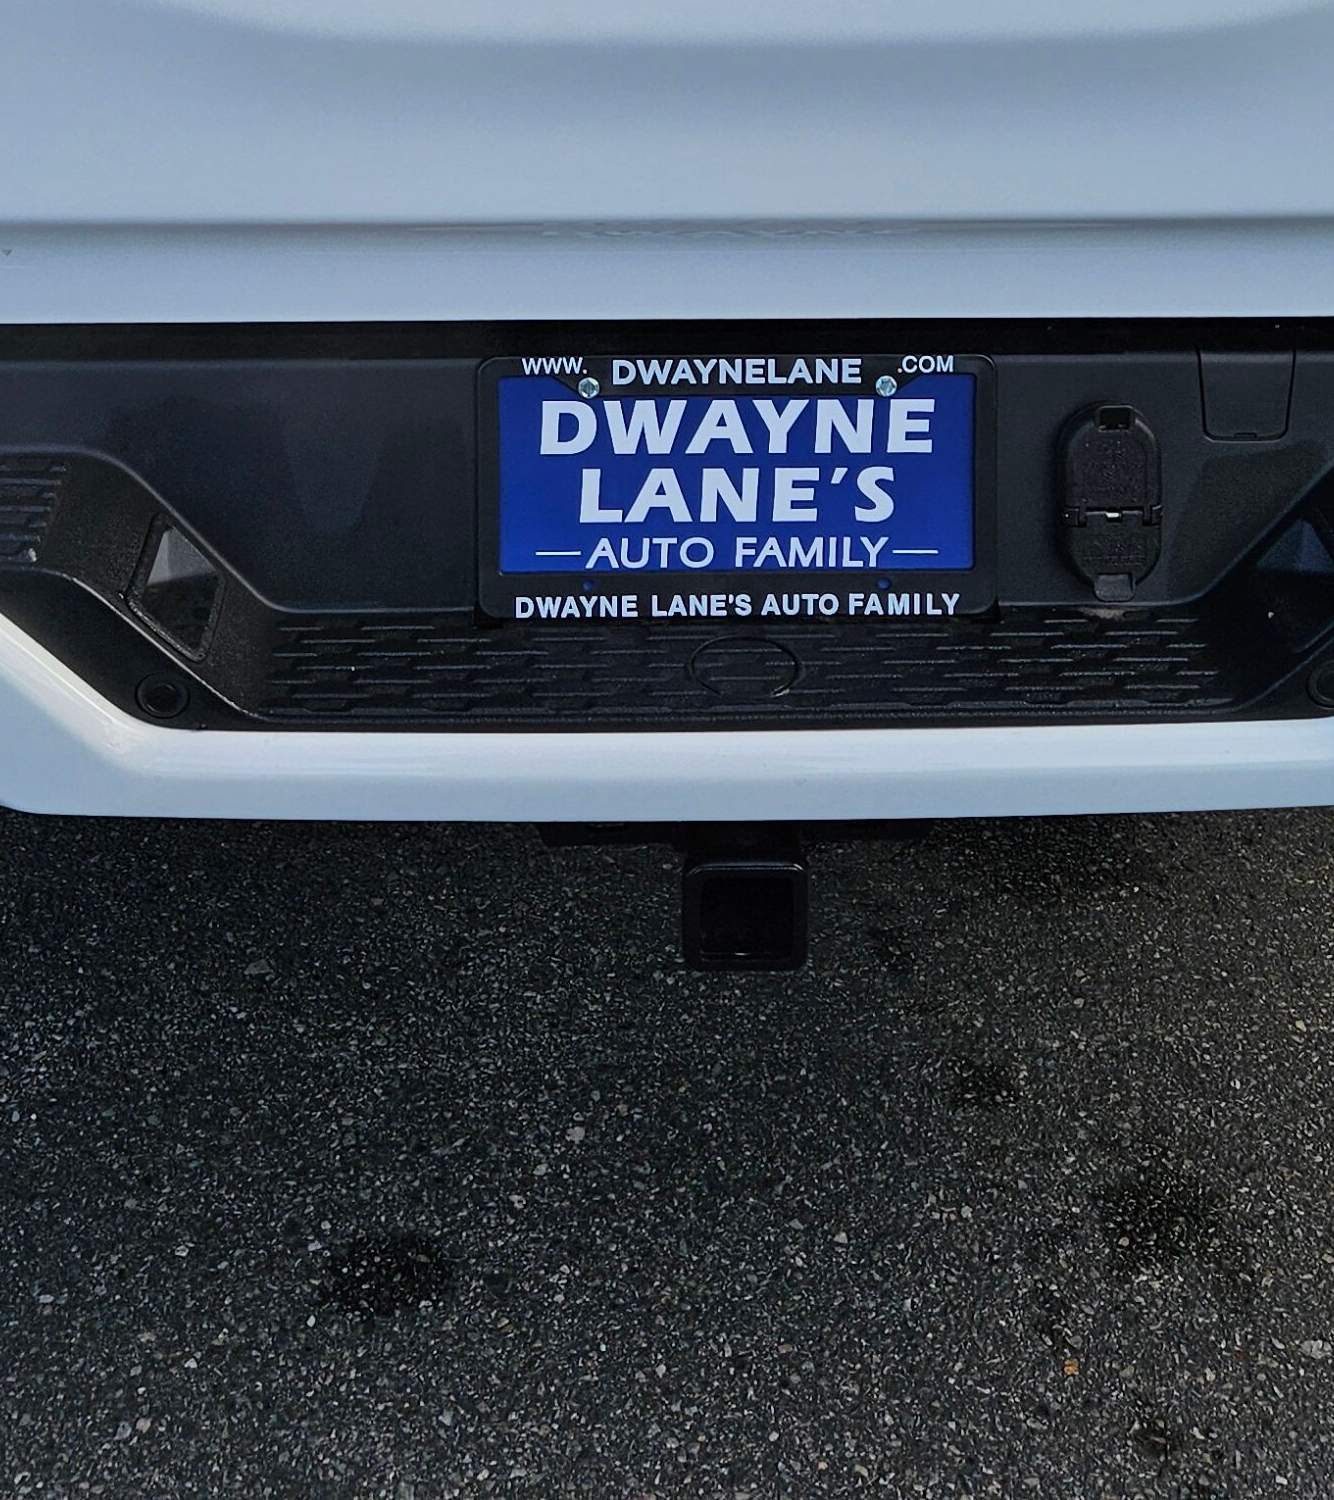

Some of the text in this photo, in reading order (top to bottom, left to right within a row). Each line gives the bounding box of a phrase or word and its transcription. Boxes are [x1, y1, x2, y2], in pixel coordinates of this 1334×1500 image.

[521, 354, 954, 386] WWW. DWAYNELANE .COM
[540, 398, 935, 455] DWAYNE
[579, 465, 895, 523] LANE'S
[584, 535, 889, 570] AUTO FAMILY
[515, 592, 960, 619] DWAYNE LANE'S AUTO FAMILY
